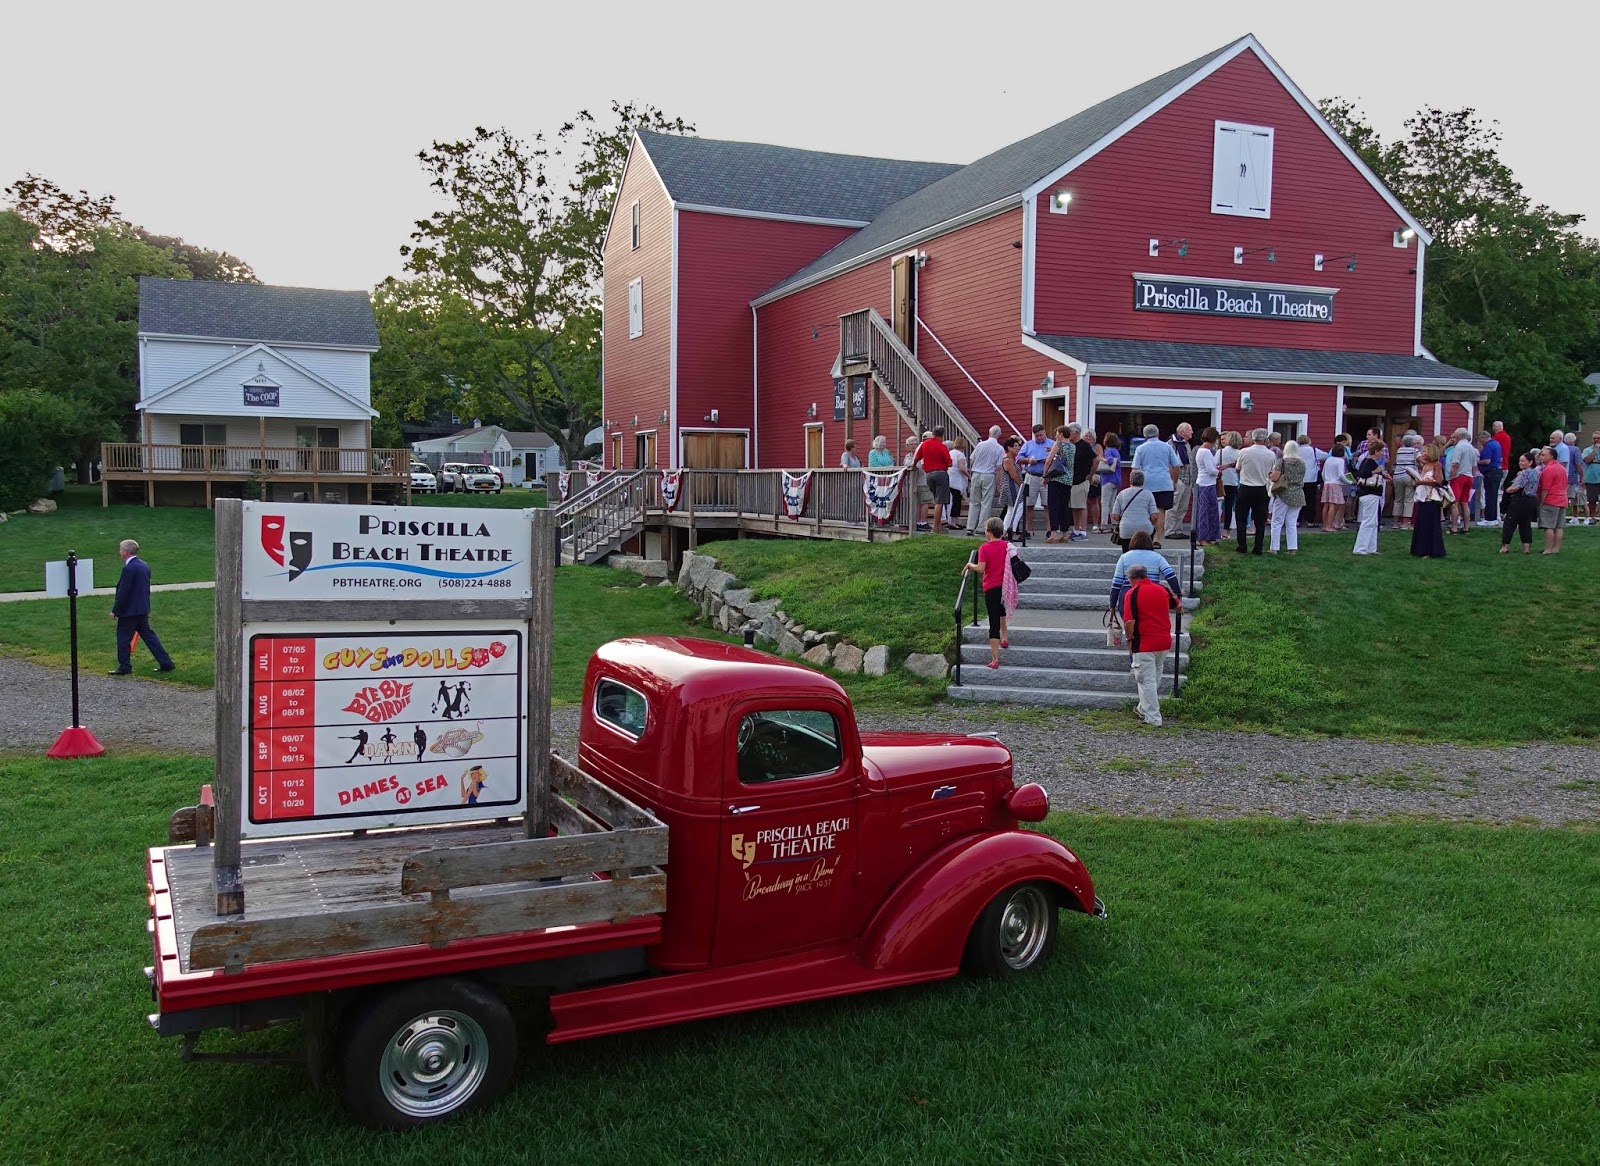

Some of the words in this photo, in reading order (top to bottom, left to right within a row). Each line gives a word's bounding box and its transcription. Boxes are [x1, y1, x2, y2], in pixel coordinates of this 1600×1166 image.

[1142, 284, 1209, 310] Priscilla
[1214, 289, 1262, 314] Beach
[1269, 293, 1328, 319] Theatre
[246, 392, 259, 401] The
[359, 515, 490, 537] PRISCILLA
[333, 542, 409, 562] BEACH
[417, 543, 512, 562] THEATRE
[333, 578, 422, 588] PBTHEATRE.ORG
[438, 578, 512, 588] (508)224-4888
[260, 654, 268, 671] JUL
[323, 647, 389, 671] GUYS
[401, 647, 473, 670] DOLLS
[260, 695, 268, 714] AUG
[341, 687, 381, 716] BYE
[378, 680, 414, 700] BYE
[366, 696, 411, 723] BIRDIE
[259, 742, 267, 759] SEP
[363, 742, 417, 758] DAMN
[259, 786, 267, 804] OCT
[338, 775, 400, 805] DAMES
[397, 789, 411, 803] AT
[416, 774, 448, 796] SEA
[757, 824, 812, 844] PRISCILLA
[816, 817, 850, 835] BEACH
[770, 834, 836, 858] THEATRE
[796, 883, 812, 896] SINCE
